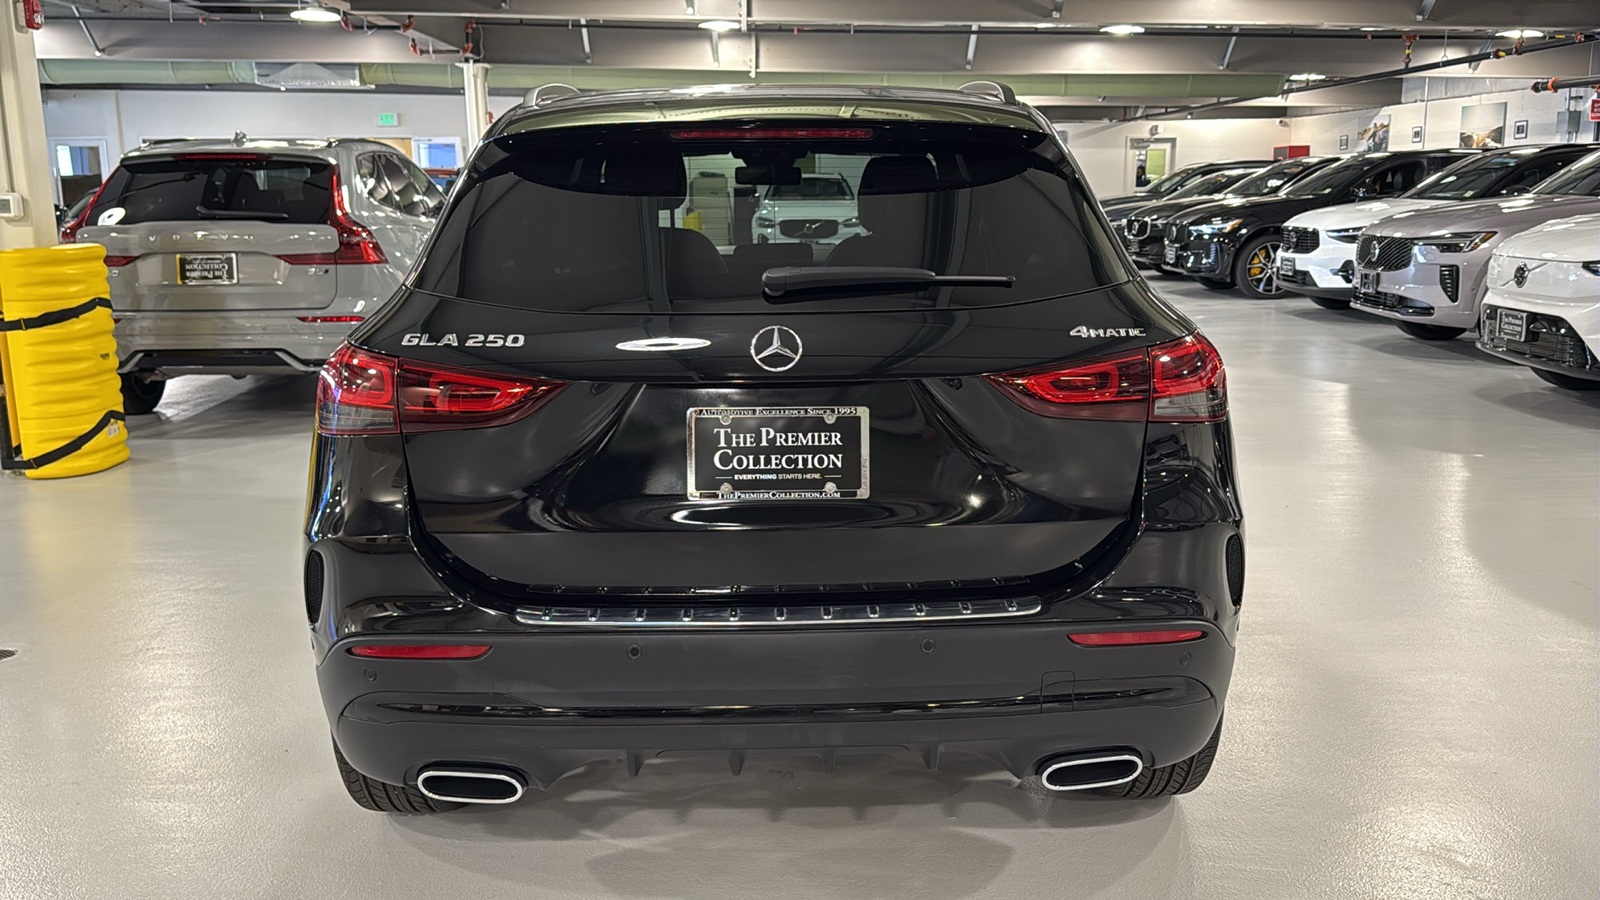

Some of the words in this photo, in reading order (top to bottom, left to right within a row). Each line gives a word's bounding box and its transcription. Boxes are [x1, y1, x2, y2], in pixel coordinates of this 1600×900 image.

[1069, 325, 1147, 338] 4MATIC
[401, 333, 459, 346] GLA
[464, 333, 526, 347] 250
[834, 407, 857, 415] 1995
[714, 428, 756, 448] THE
[760, 427, 843, 447] PREMIER
[713, 449, 843, 470] COLLECTION
